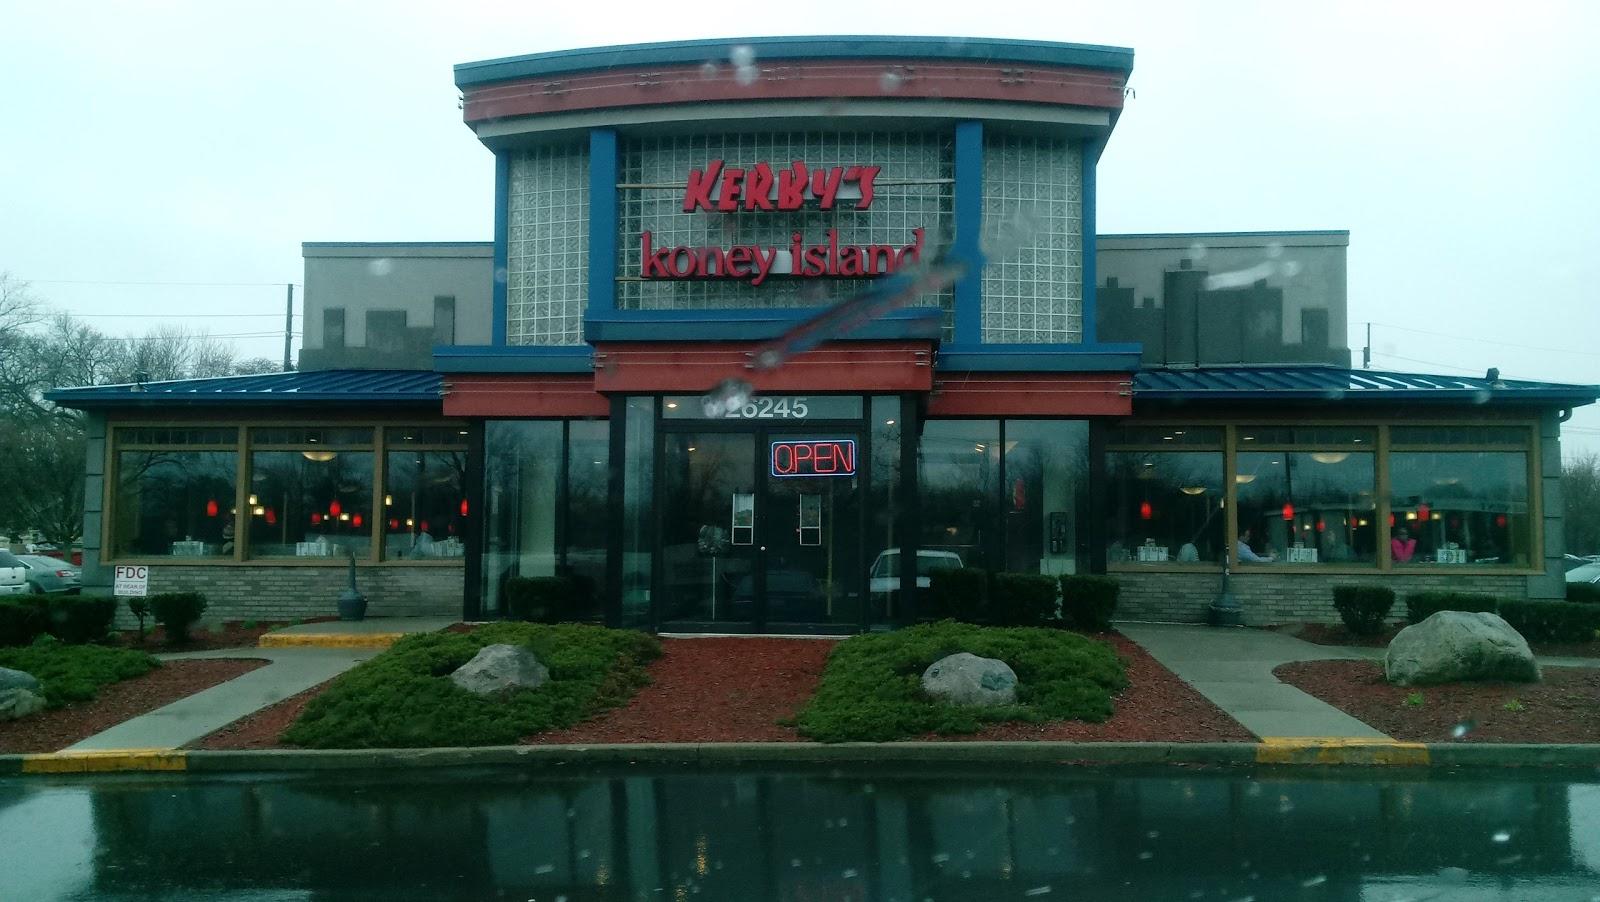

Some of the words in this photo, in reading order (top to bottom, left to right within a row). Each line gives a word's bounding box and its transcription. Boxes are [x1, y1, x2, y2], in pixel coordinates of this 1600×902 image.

[641, 231, 776, 286] koney
[774, 443, 852, 474] OPEN
[116, 567, 146, 579] FDC
